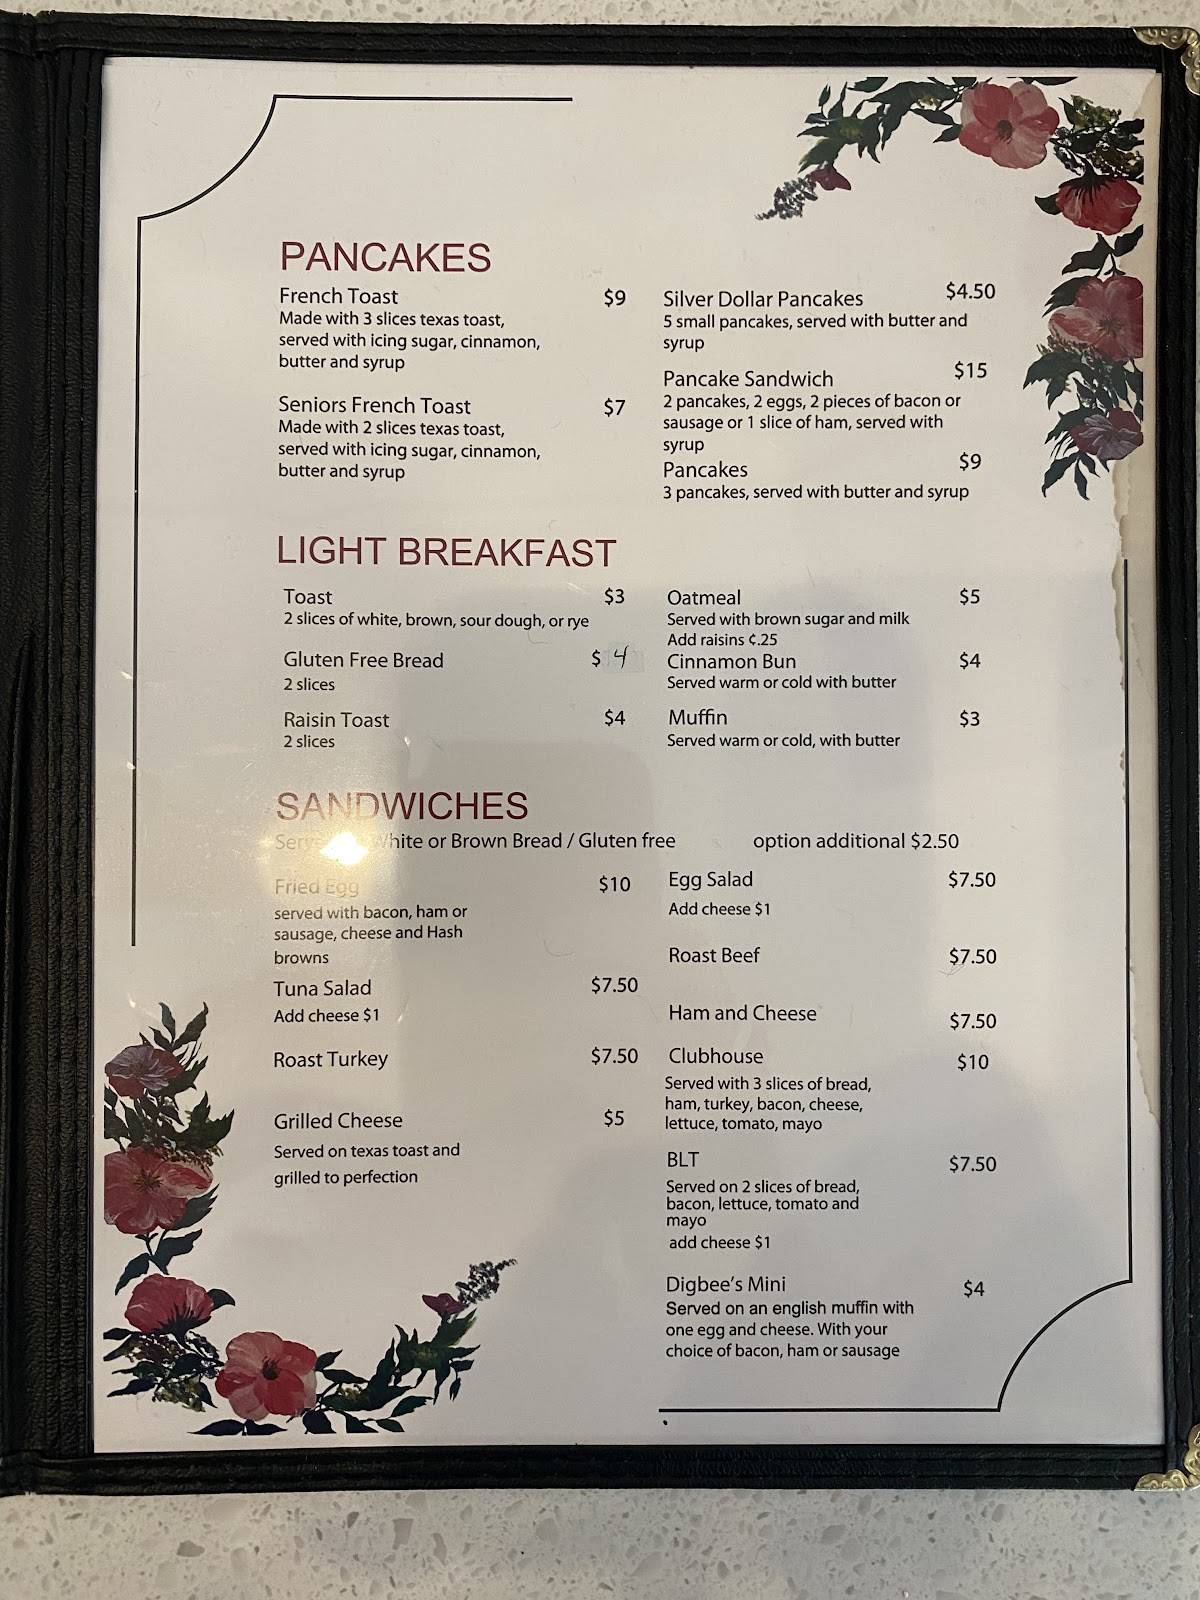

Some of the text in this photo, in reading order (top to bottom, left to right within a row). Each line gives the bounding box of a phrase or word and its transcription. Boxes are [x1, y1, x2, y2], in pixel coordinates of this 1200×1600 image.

[281, 241, 492, 273] PANCAKES
[280, 286, 399, 305] French Toast
[603, 287, 627, 309] $9
[663, 288, 864, 308] Silver Dollar Pancakes
[946, 280, 996, 302] $4.50
[279, 309, 505, 329] Made with 3 slices texas toast,
[278, 331, 541, 352] served with icing sugar, cinnamon,
[279, 353, 406, 373] butter and syrup
[954, 360, 988, 381] $15
[663, 369, 834, 388] Pancake Sandwich
[278, 395, 472, 415] Seniors French Toast
[603, 397, 626, 418] $7
[663, 392, 962, 413] 2 pancakes, 2 eggs, 2 pieces of bacon or
[663, 459, 749, 479] Pancakes
[959, 451, 982, 472] $9
[278, 535, 618, 568] LIGHT BREAKFAST
[282, 588, 333, 605] Toast
[604, 586, 625, 606] $3
[667, 588, 741, 606] Oatmeal
[959, 587, 981, 606] $5
[283, 610, 590, 631] 2 slices of white, brown, sour dough, or rye
[666, 632, 697, 647] Add
[700, 633, 745, 647] raisins
[283, 650, 444, 669] Gluten Free Bread
[667, 653, 797, 670] Cinnamon Bun
[959, 651, 982, 671] $4
[283, 676, 336, 692] 2 slices
[284, 711, 391, 728] Raisin Toast
[604, 708, 626, 728] $4
[668, 708, 728, 726] Muffin
[959, 708, 981, 729] $3
[667, 732, 901, 749] Served warm or cold, with butter
[276, 791, 529, 821] SANDWICHES
[427, 836, 448, 849] or
[451, 832, 508, 849] Brown
[512, 831, 563, 849] Bread
[566, 832, 576, 849] /
[578, 831, 637, 849] Gluten
[641, 831, 676, 849] free
[753, 831, 960, 853] option additional $2.50
[275, 877, 360, 899] Fried Egg
[599, 874, 631, 894] $10
[669, 870, 753, 892] Egg Salad
[948, 869, 997, 889] $7.50
[273, 924, 463, 944] sausage, cheese and Hash
[274, 950, 330, 965] browns
[669, 946, 761, 964] Roast Beef
[949, 946, 997, 967] $7.50
[272, 978, 372, 997] Tuna Salad
[591, 975, 639, 995] $7.50
[273, 1007, 379, 1024] Add cheese $1
[669, 1003, 817, 1022] Ham and Cheese
[949, 1011, 997, 1032] $7.50
[273, 1049, 389, 1071] Roast Turkey
[591, 1045, 639, 1066] $7.50
[668, 1046, 764, 1065] Clubhouse
[957, 1052, 990, 1072] $10
[664, 1075, 872, 1093] Served with 3 slices of bread,
[273, 1111, 404, 1130] Grilled Cheese
[603, 1108, 625, 1128] $5
[665, 1115, 823, 1134] lettuce, tomato, mayo
[667, 1151, 700, 1168] BLT
[949, 1154, 997, 1174] $7.50
[273, 1169, 418, 1189] grilled to perfection
[747, 1275, 786, 1293] Mini
[963, 1278, 986, 1299] $4
[665, 1299, 915, 1319] Served on an english muffin with
[665, 1342, 901, 1361] choice of bacon, ham or sausage
